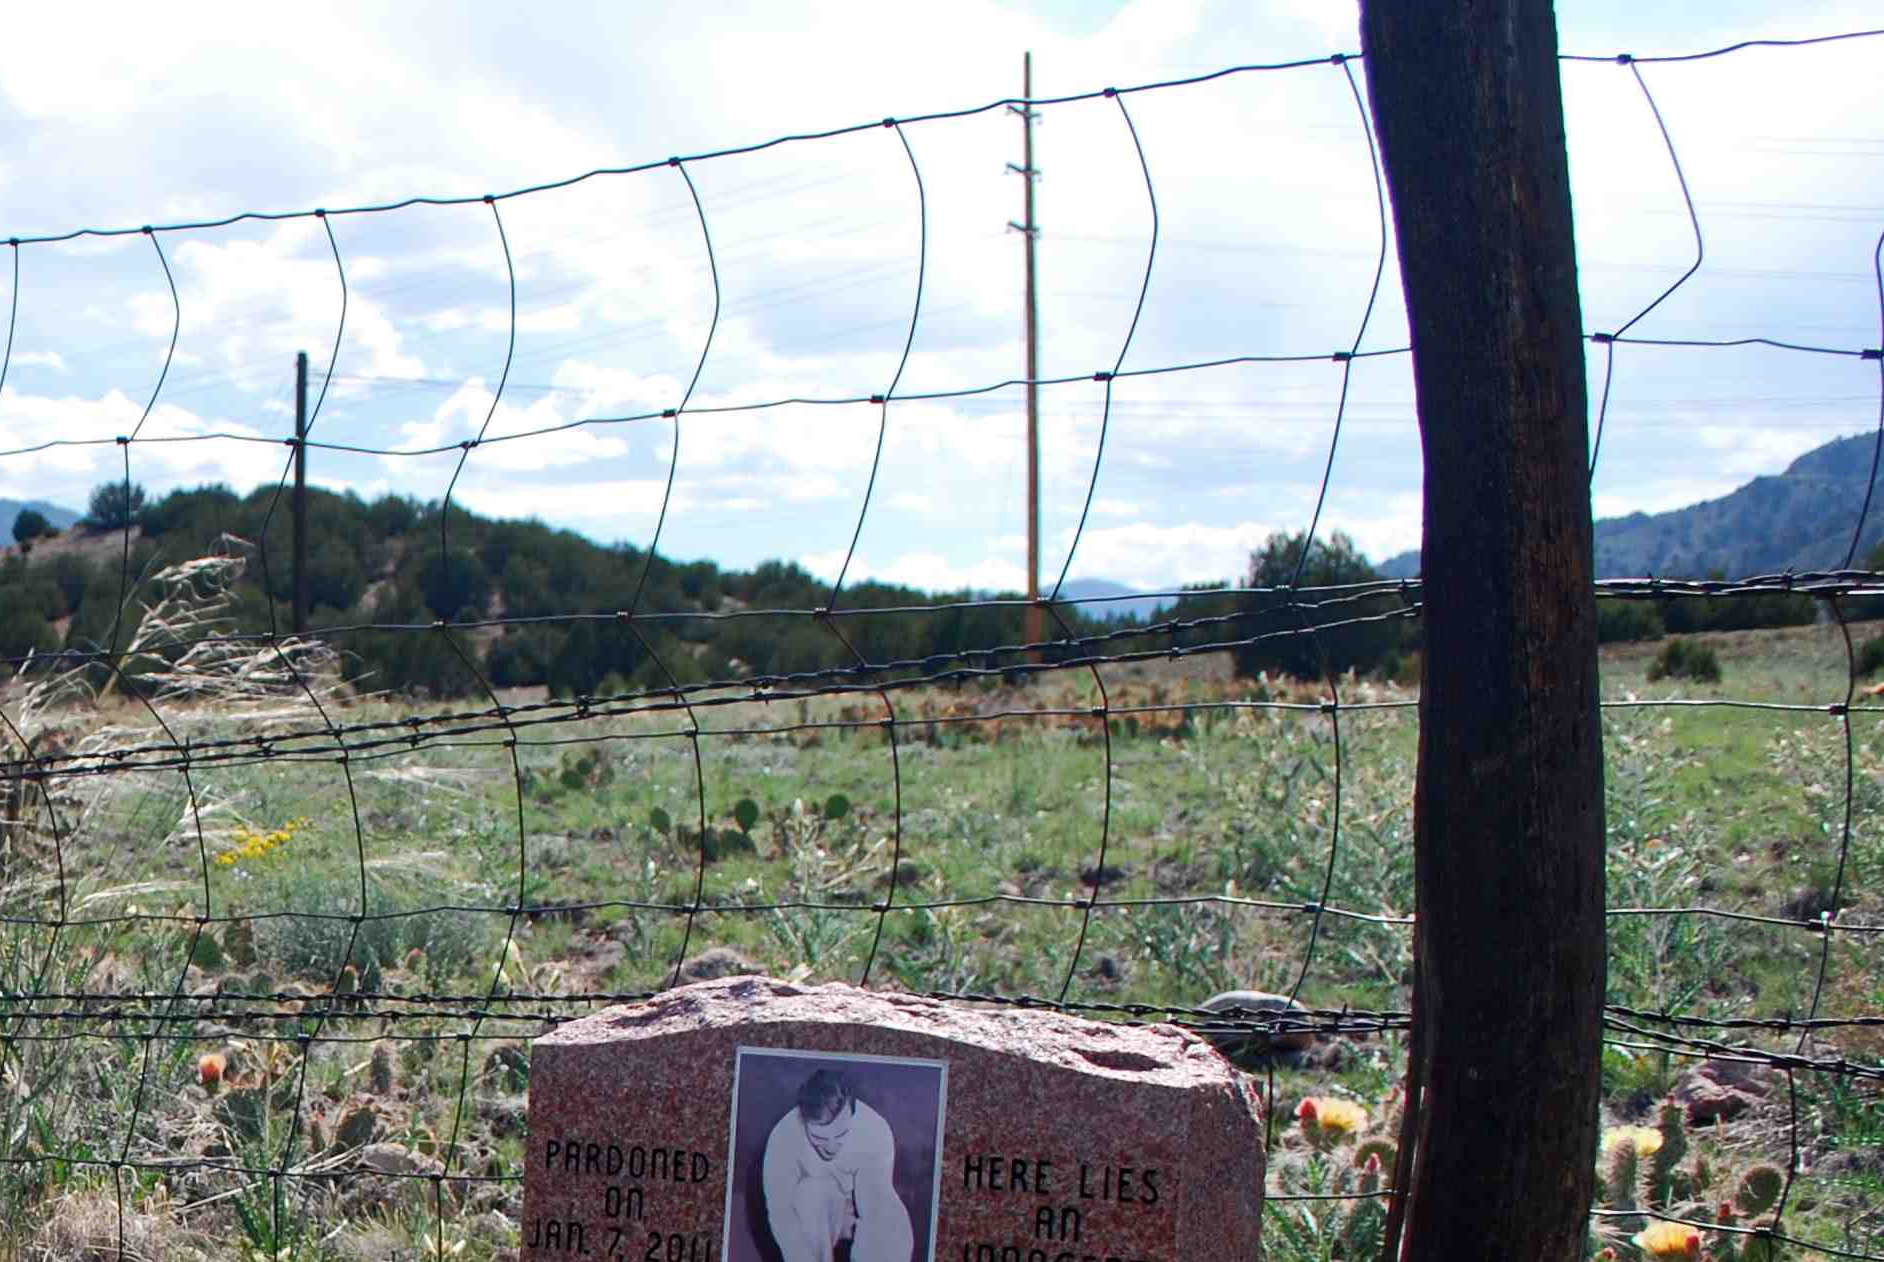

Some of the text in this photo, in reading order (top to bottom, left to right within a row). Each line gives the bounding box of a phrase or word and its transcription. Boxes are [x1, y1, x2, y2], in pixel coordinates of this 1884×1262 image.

[545, 1139, 710, 1184] PARDONED
[963, 1154, 1160, 1205] HERE LIES
[604, 1185, 644, 1221] ON
[527, 1217, 592, 1256] JAN.
[1034, 1205, 1082, 1243] AN
